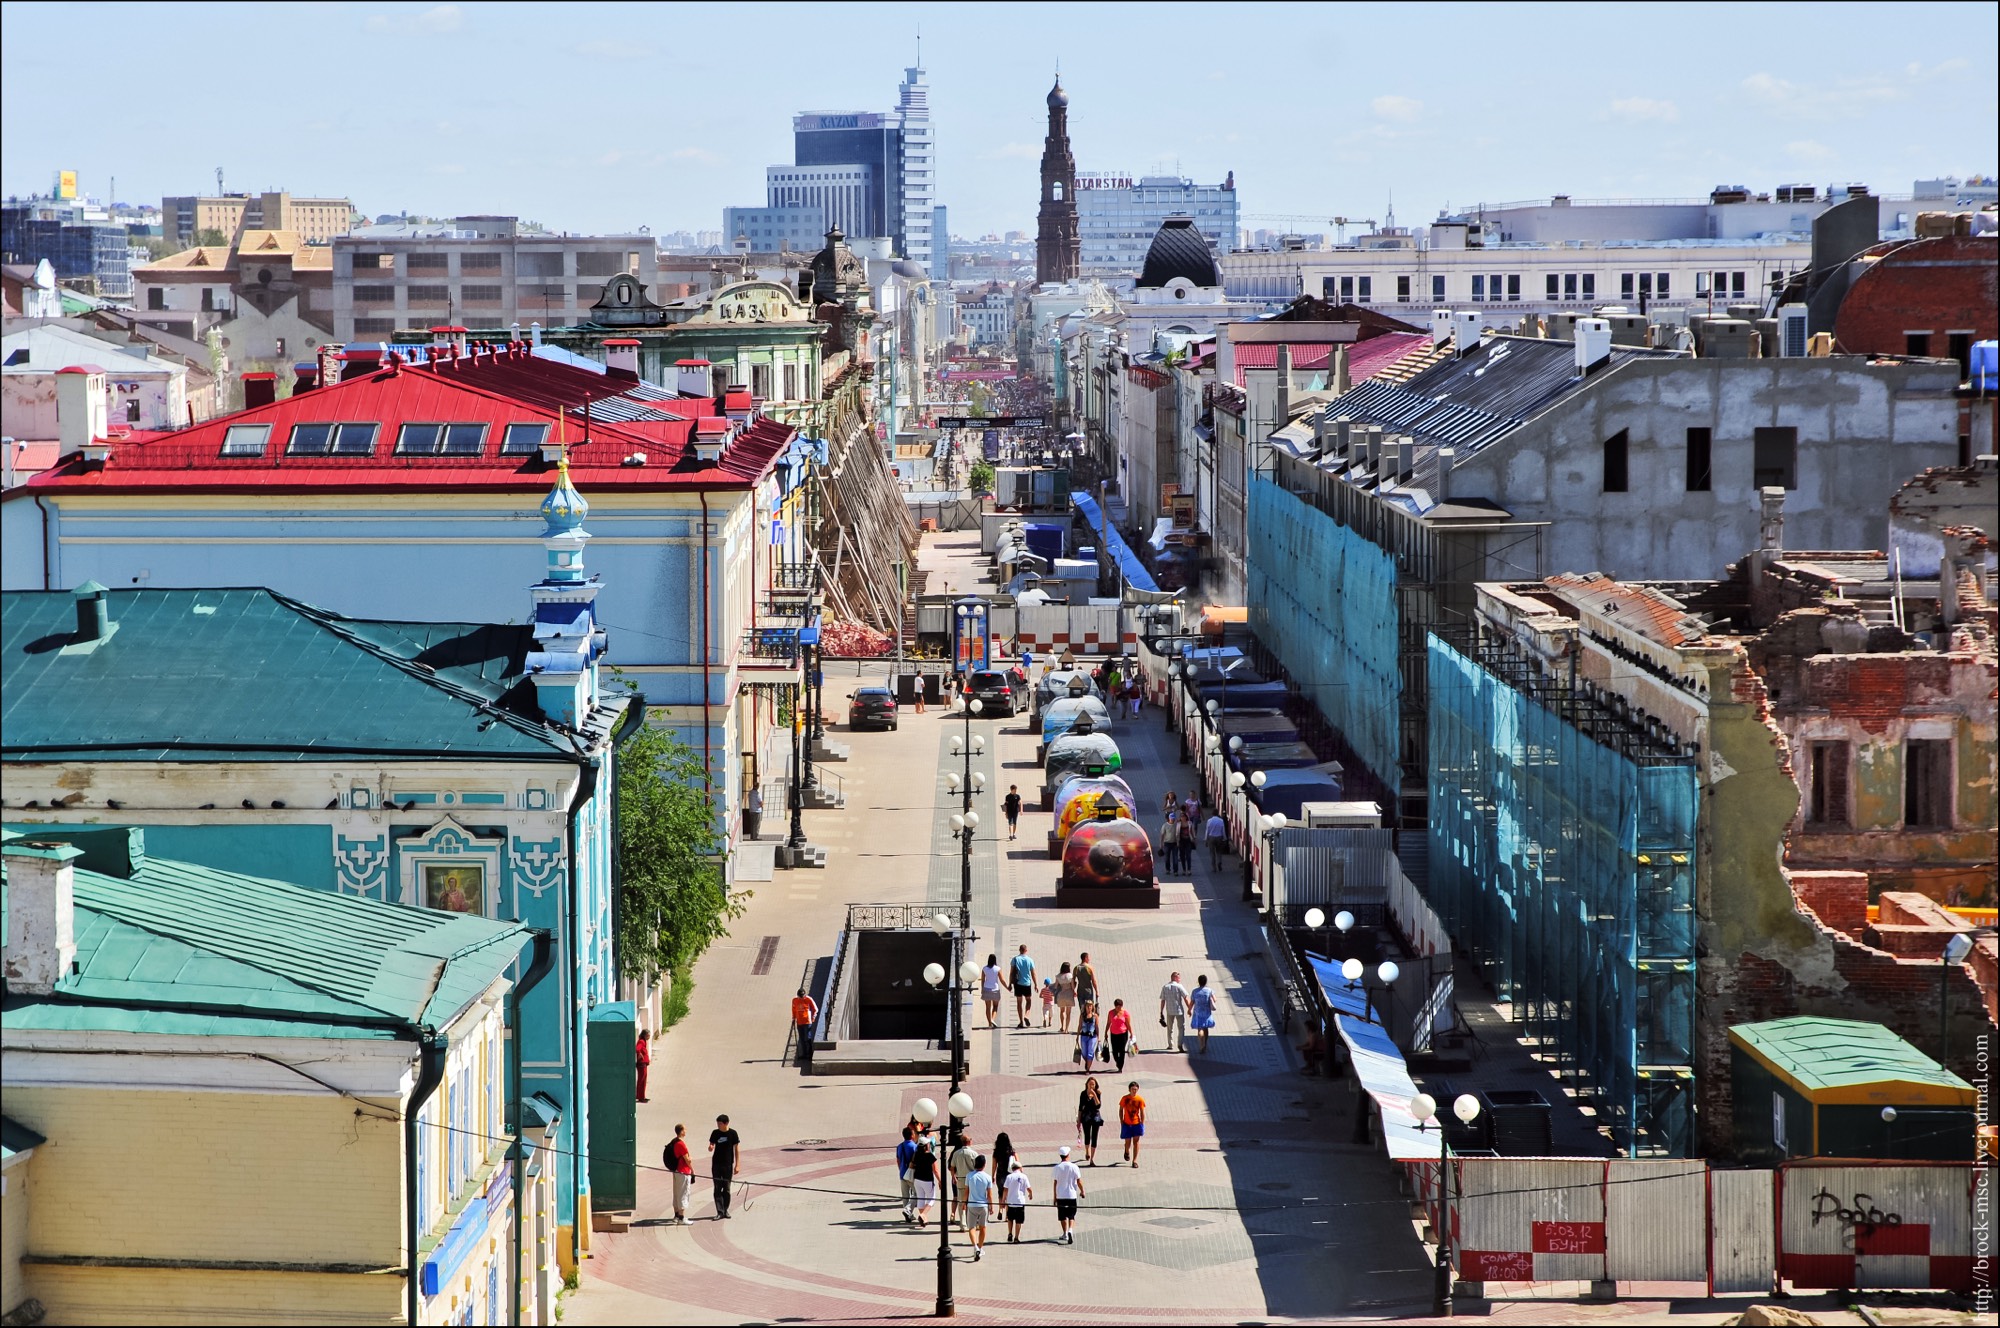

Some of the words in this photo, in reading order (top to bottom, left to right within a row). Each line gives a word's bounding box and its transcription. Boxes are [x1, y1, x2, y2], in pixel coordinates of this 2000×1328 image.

[820, 115, 858, 129] KAZAN
[1074, 178, 1132, 189] ATARSTAN
[720, 303, 788, 319] КАЗАНЬ
[1549, 1239, 1588, 1253] БУНТ
[1485, 1265, 1518, 1280] 18:00
